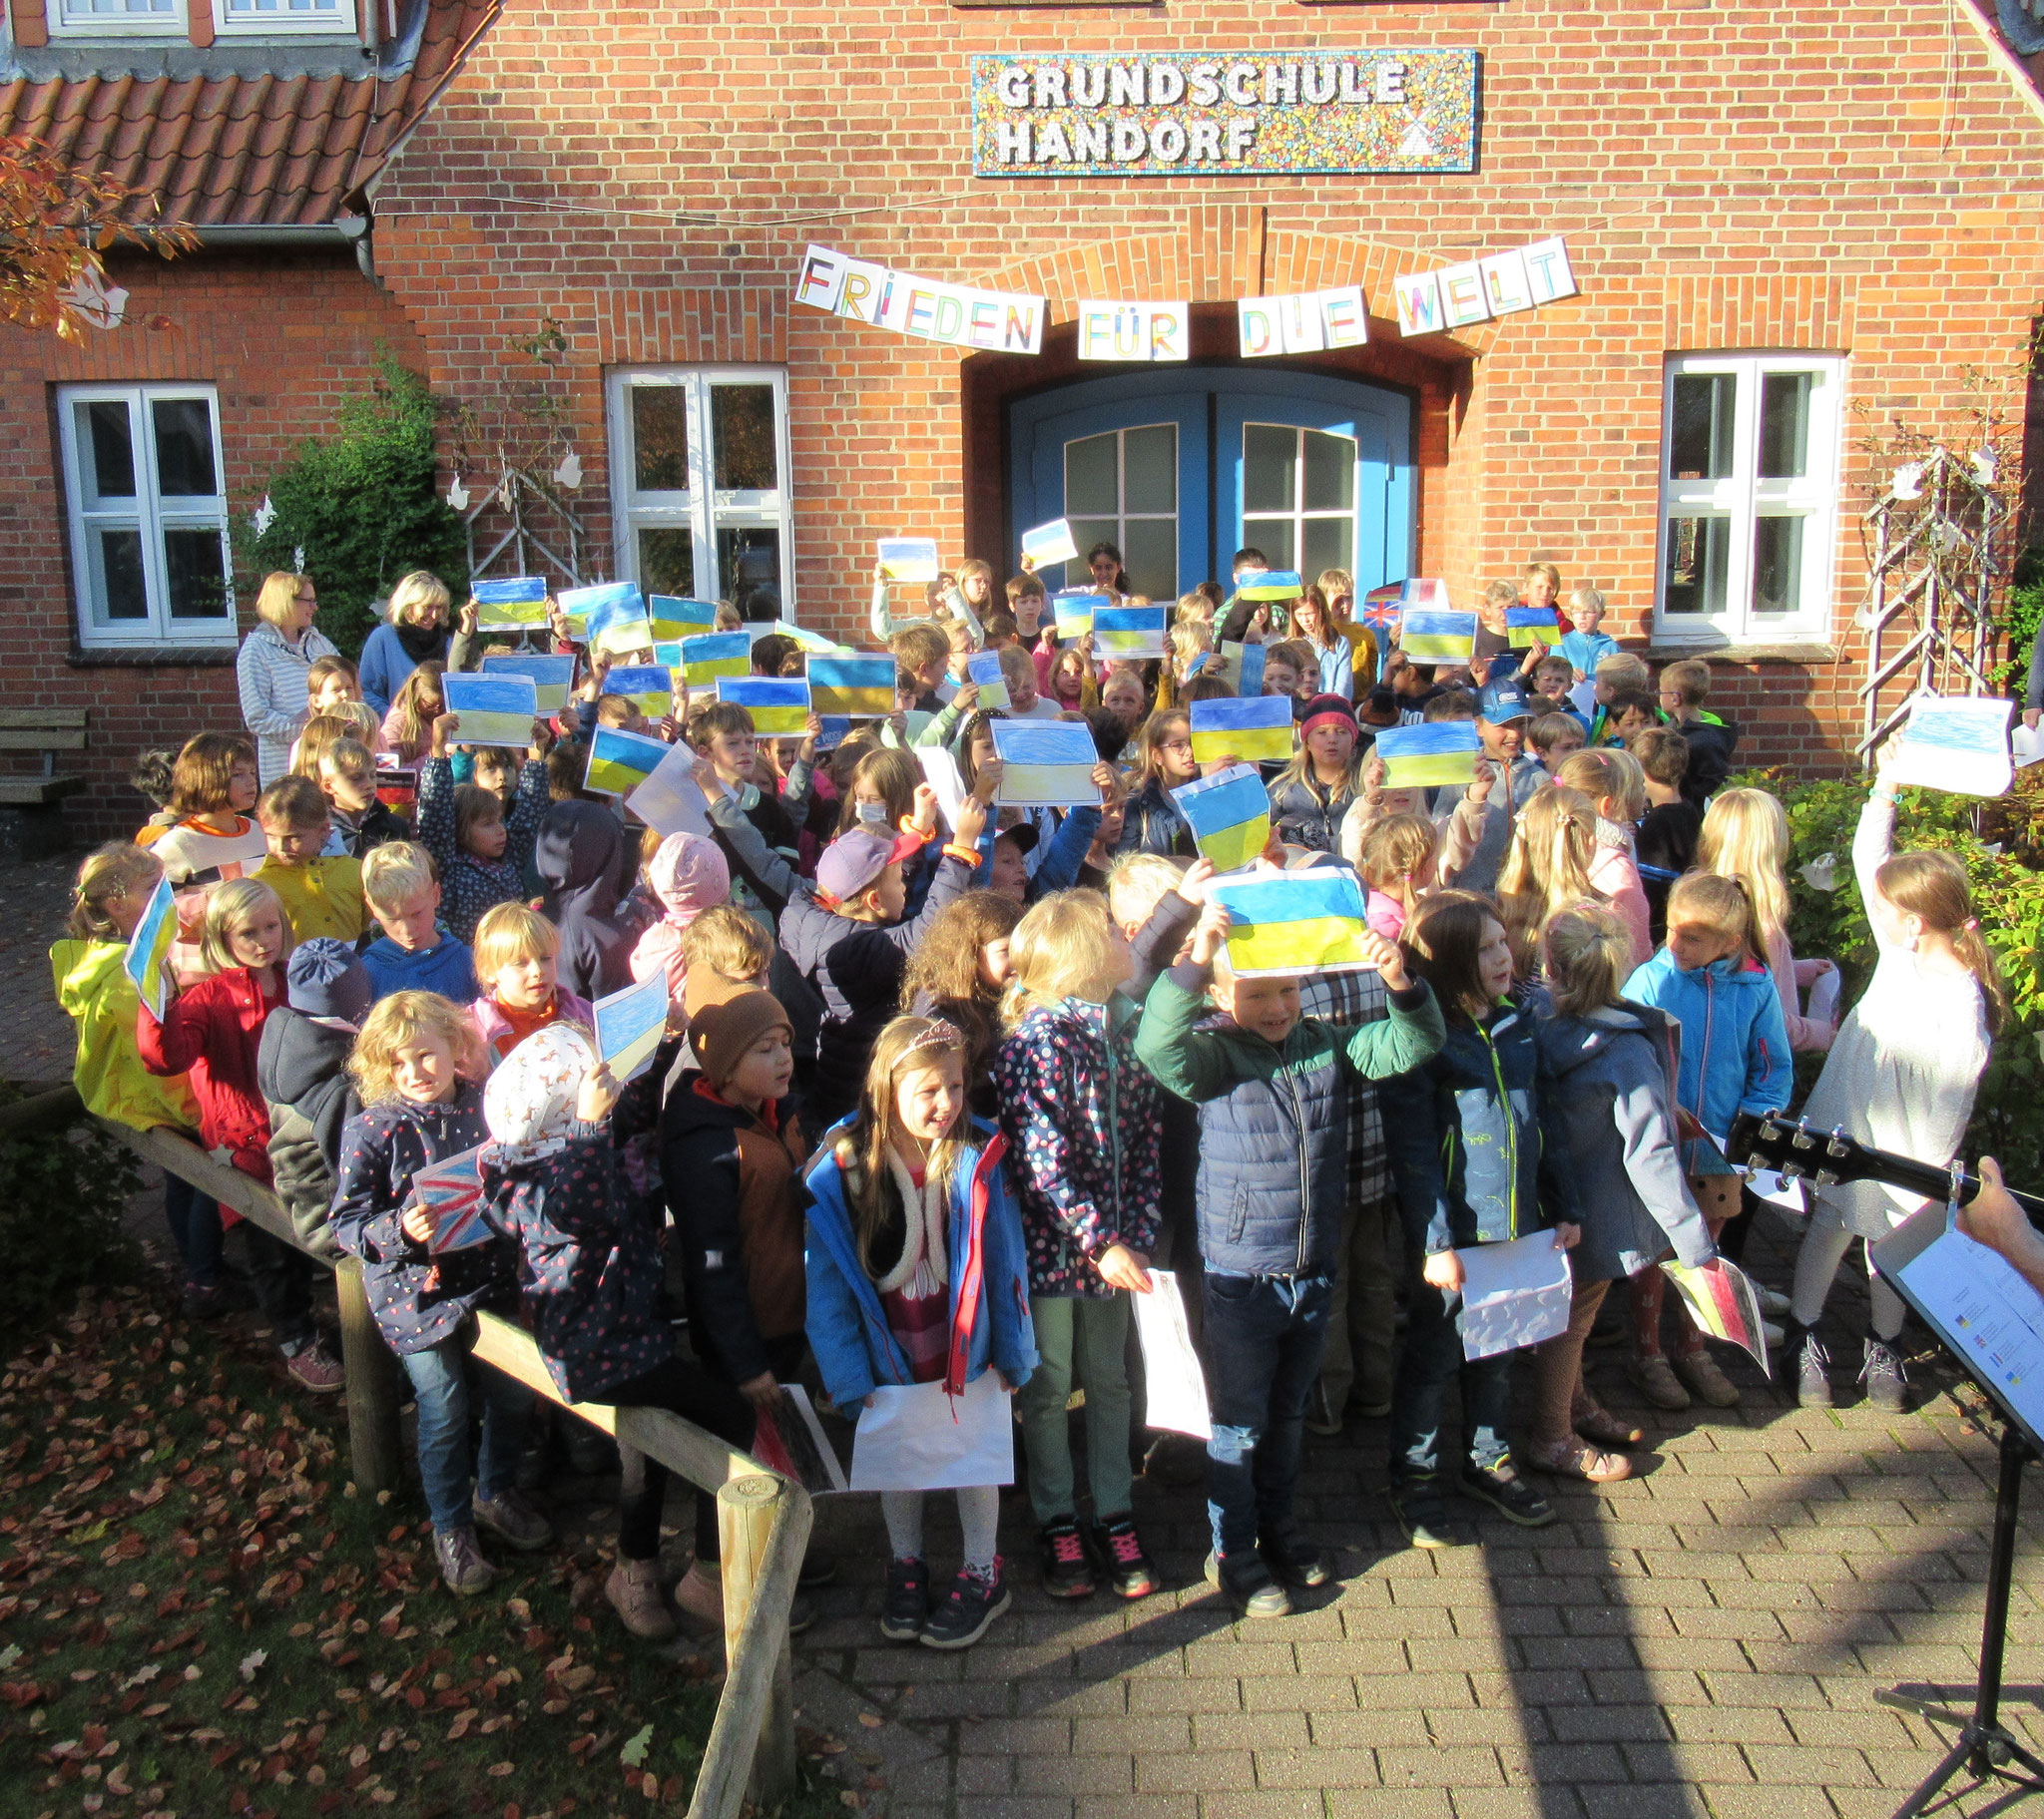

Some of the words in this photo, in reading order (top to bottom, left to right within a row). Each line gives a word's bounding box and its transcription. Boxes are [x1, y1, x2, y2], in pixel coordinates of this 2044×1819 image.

[997, 62, 1408, 108] GRUNDSCHULE
[997, 117, 1257, 163] HANDORF
[1083, 305, 1178, 358] FÜR
[1243, 295, 1358, 355] DIE
[1397, 250, 1557, 331] WELT
